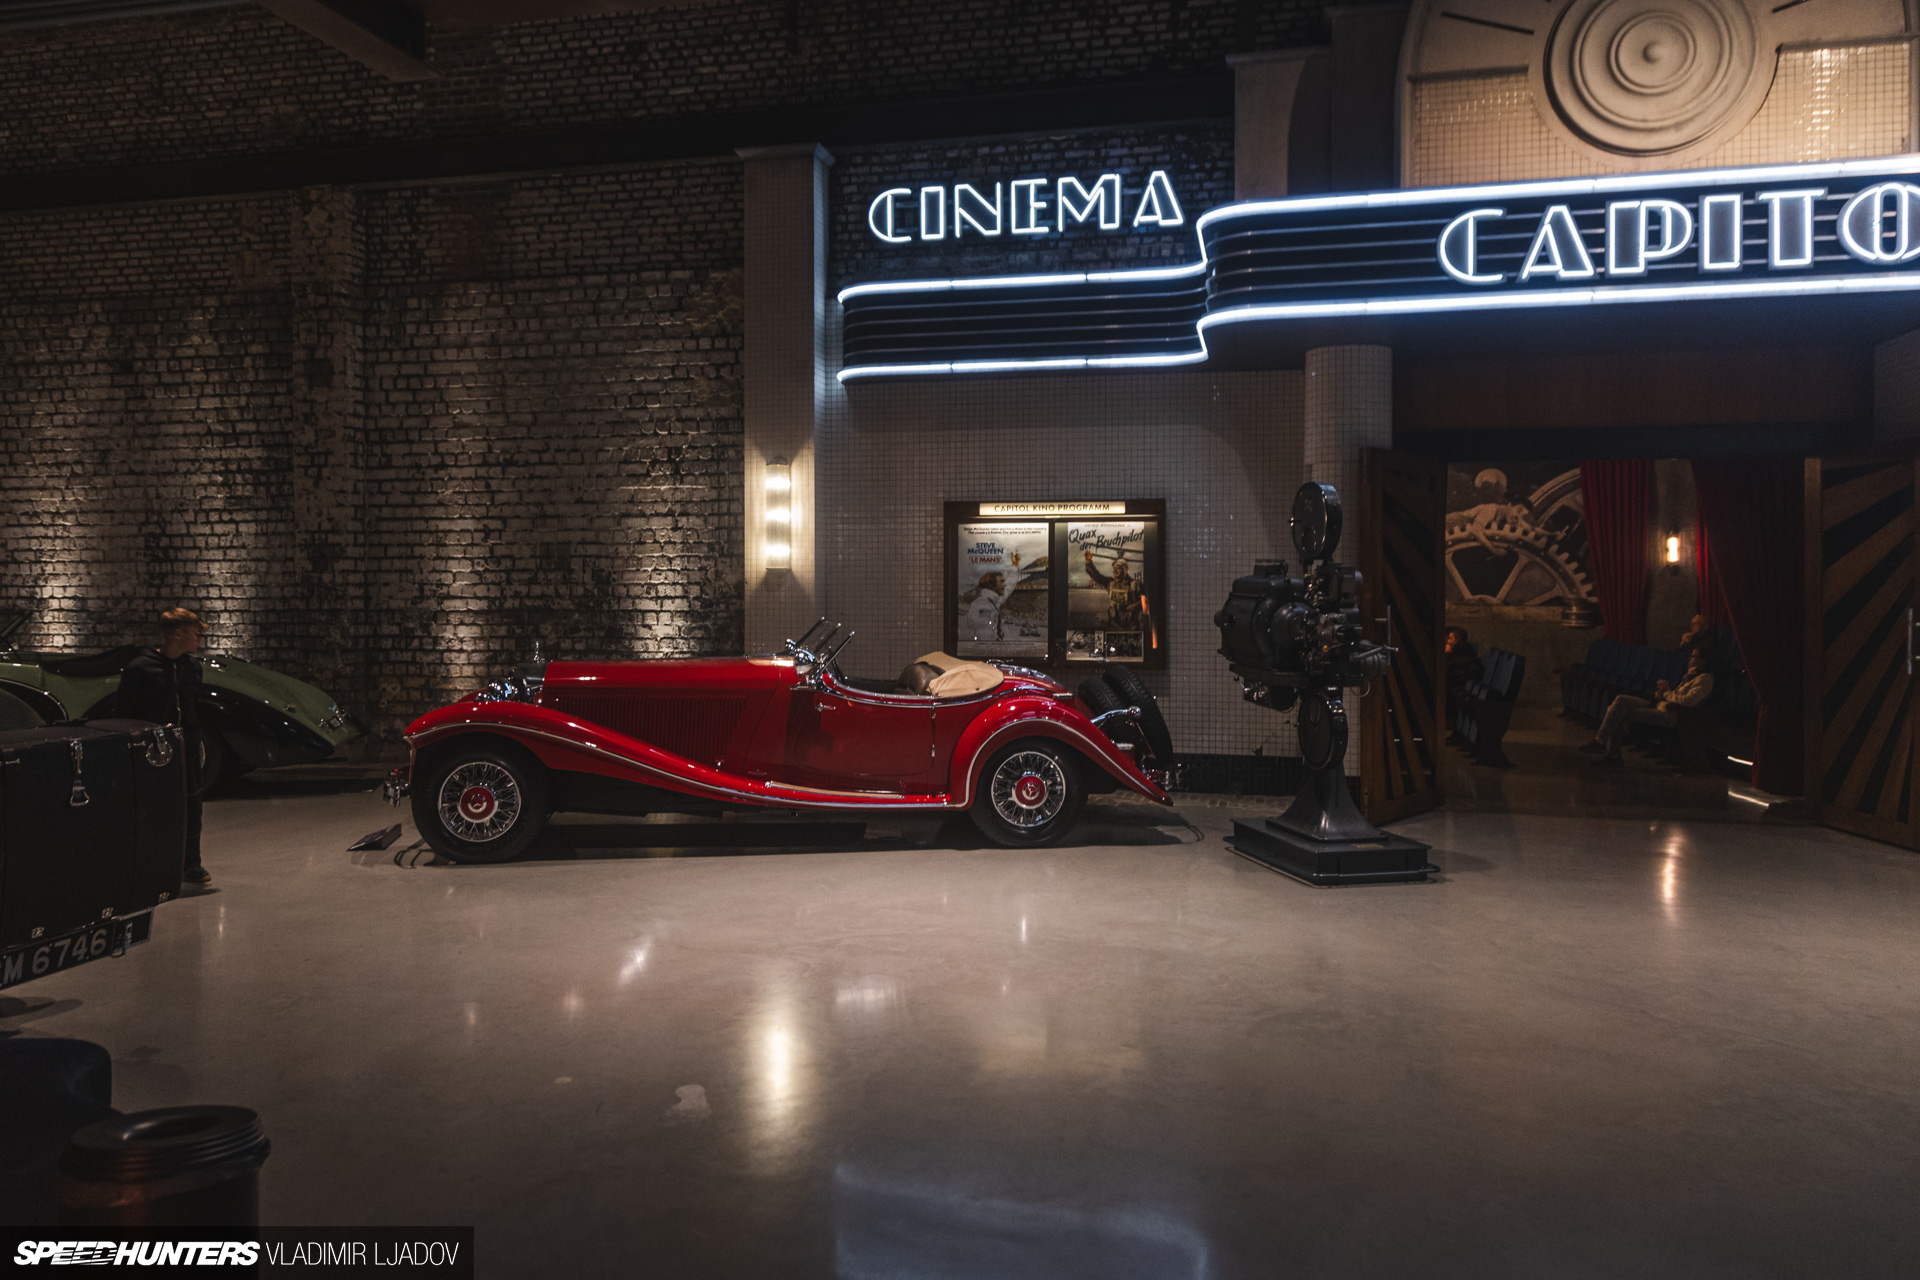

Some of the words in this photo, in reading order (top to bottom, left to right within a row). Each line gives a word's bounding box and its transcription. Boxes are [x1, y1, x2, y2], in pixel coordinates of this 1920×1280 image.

[867, 169, 1185, 244] CINEMA
[1437, 180, 1920, 284] CAPITO
[994, 504, 1029, 513] CAPITOL
[1032, 503, 1055, 512] KINO
[1058, 502, 1110, 511] PROGRAMM
[1068, 528, 1096, 543] Quax
[1096, 529, 1144, 548] Bruchpilot
[0, 951, 25, 987] M
[31, 928, 108, 976] 6746
